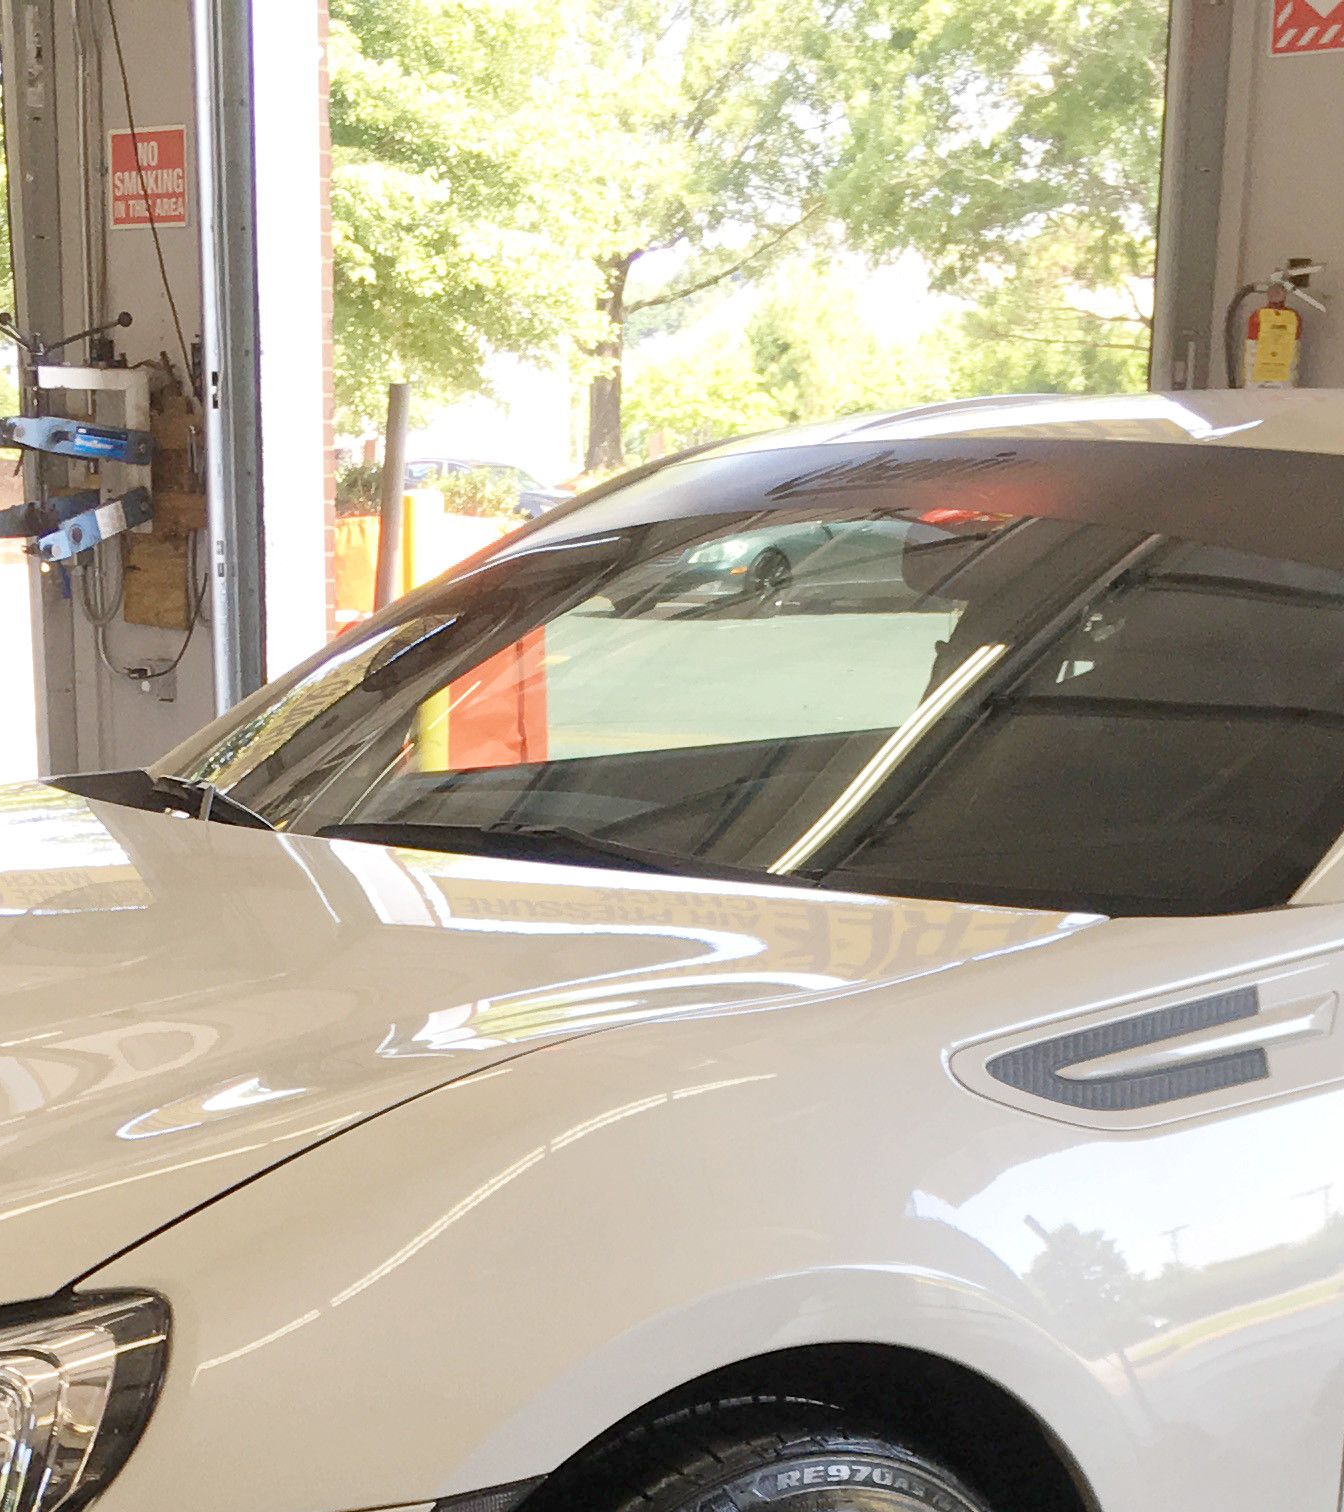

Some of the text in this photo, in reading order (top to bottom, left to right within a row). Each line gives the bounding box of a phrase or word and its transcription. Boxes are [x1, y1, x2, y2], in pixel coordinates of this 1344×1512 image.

[136, 141, 158, 166] NO
[114, 200, 126, 217] IN
[155, 197, 184, 216] AREA
